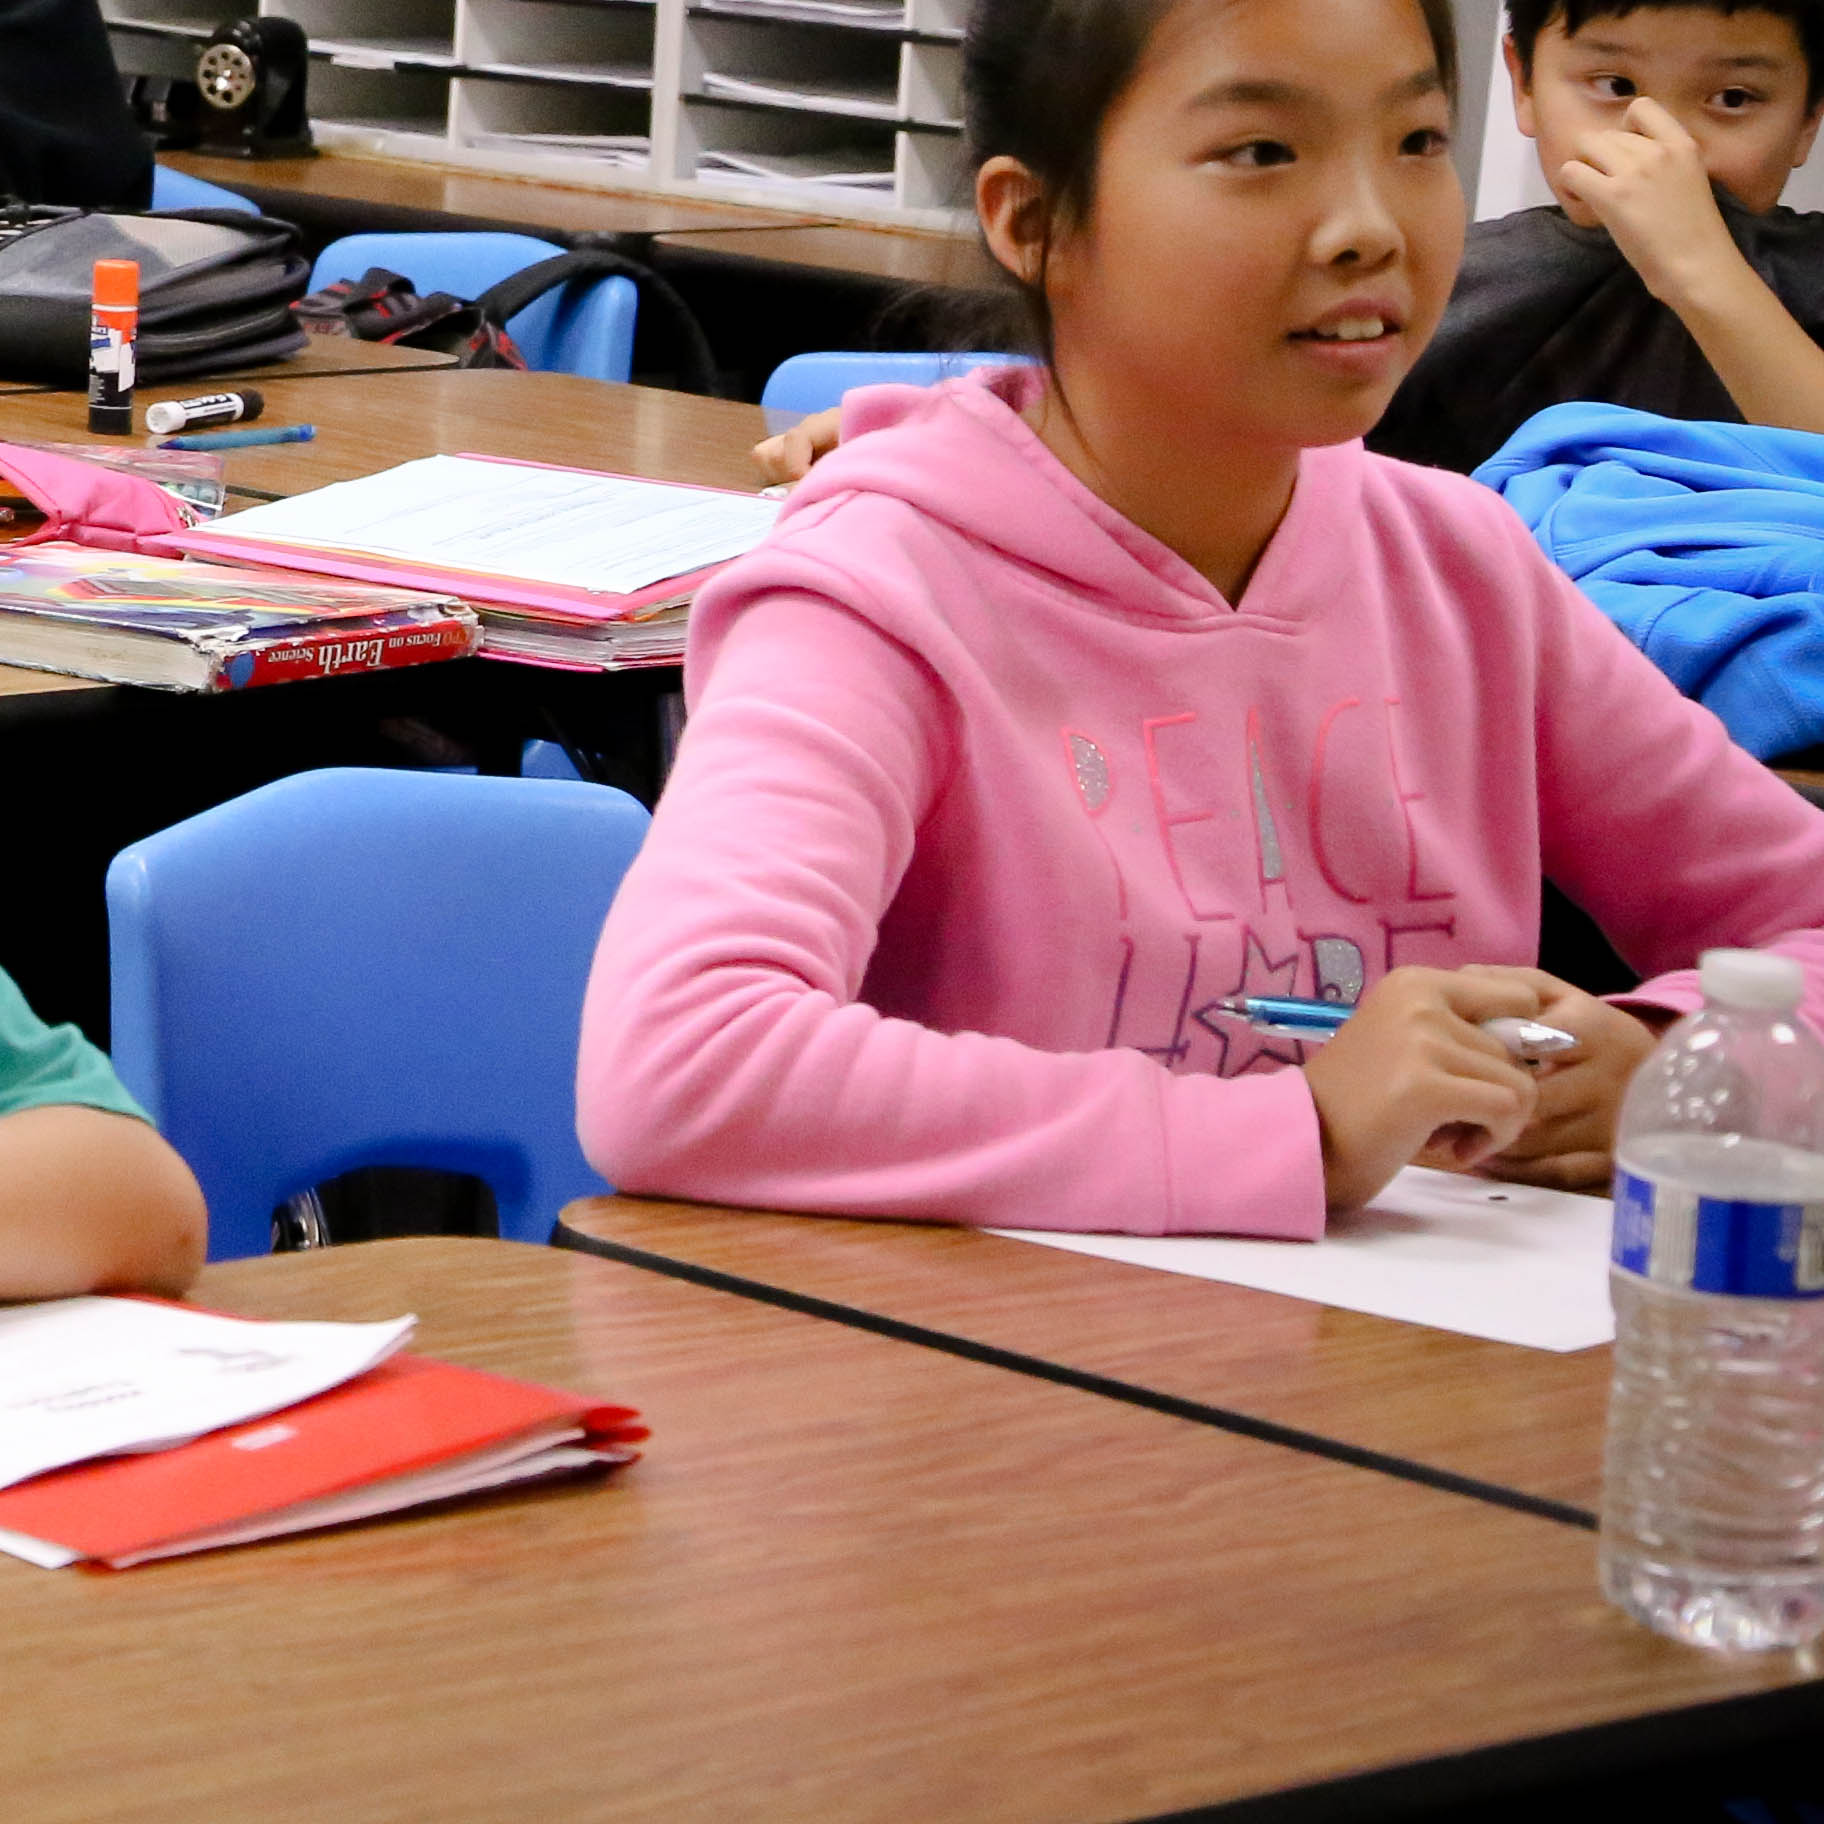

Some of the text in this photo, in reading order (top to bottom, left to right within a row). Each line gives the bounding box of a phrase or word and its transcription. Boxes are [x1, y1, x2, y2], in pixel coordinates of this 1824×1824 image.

[389, 637, 405, 649] on
[406, 631, 442, 647] Focus
[267, 647, 315, 664] Science
[317, 637, 386, 674] Earth
